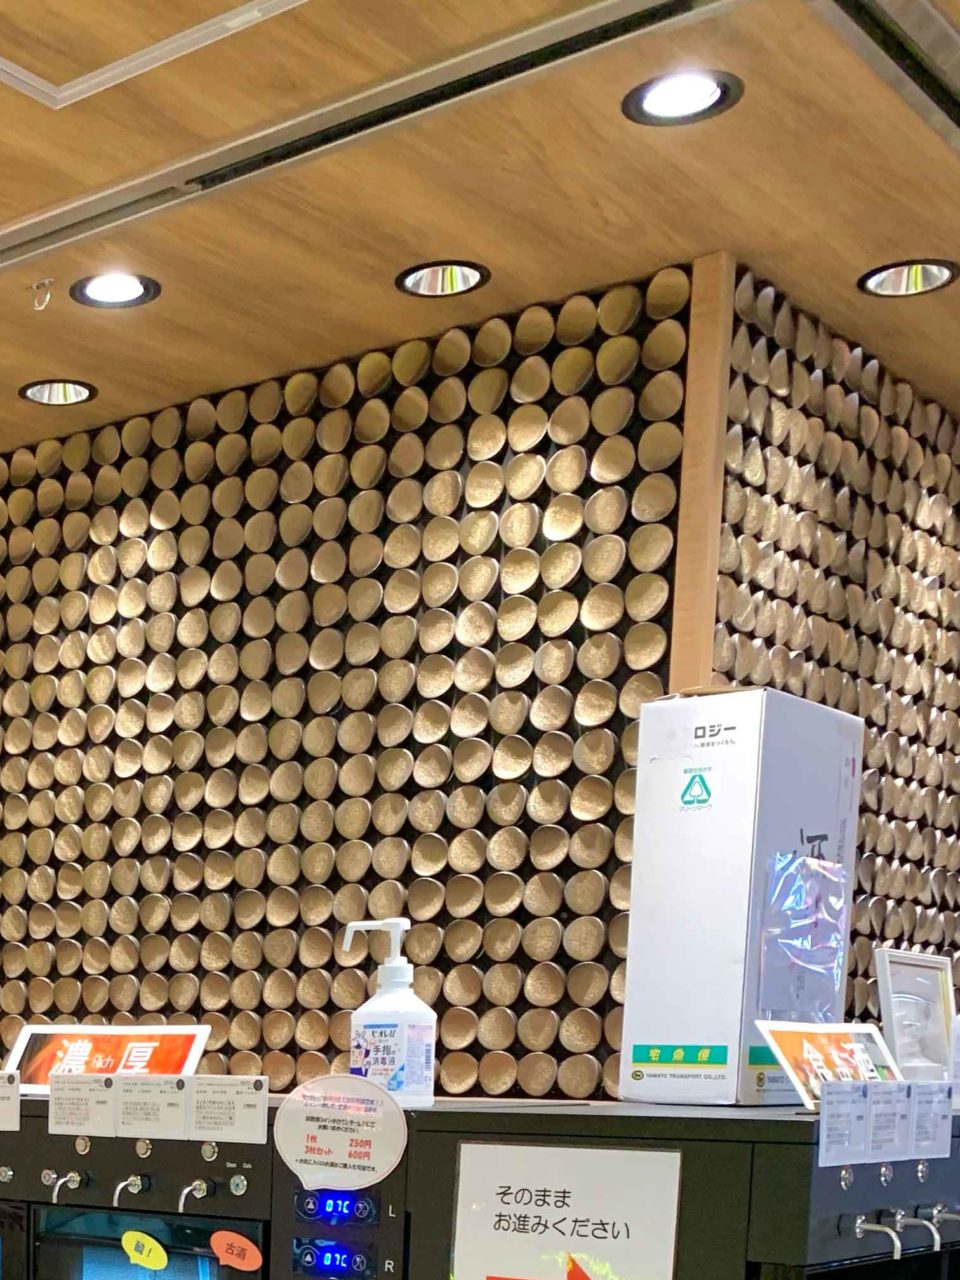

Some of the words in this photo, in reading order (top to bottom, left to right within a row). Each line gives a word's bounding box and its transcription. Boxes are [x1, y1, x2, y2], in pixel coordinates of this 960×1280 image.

[694, 724, 737, 739] ロジー
[349, 1138, 372, 1149] 250円
[348, 1150, 371, 1160] 600円
[495, 1185, 572, 1209] そのまま
[388, 1204, 396, 1217] L
[493, 1212, 631, 1240] お進みください
[224, 1242, 248, 1261] 古酒
[384, 1260, 394, 1273] R
